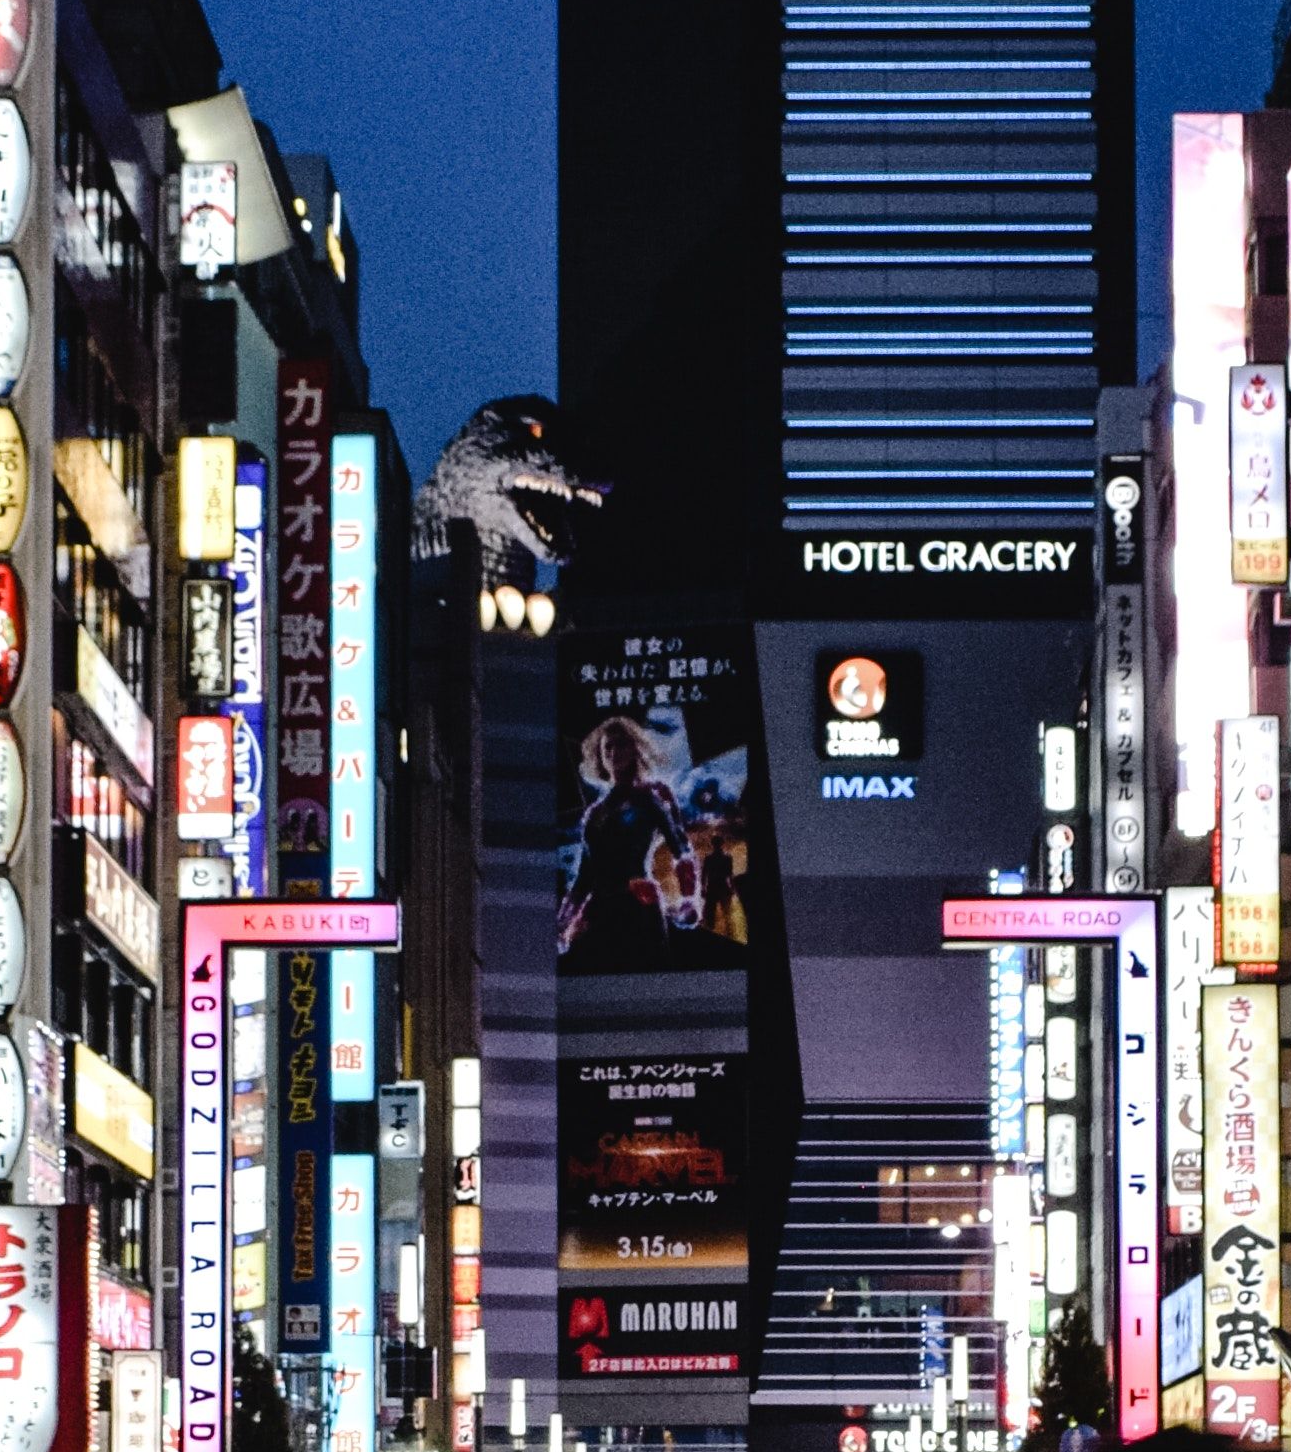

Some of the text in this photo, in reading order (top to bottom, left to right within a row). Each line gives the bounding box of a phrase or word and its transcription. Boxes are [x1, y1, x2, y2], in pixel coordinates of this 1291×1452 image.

[282, 378, 324, 776] カラオケ歌広場
[804, 540, 1077, 572] HOTEL GRACERY
[334, 467, 363, 1071] カラオケ&パーテー館
[821, 775, 916, 799] IMAX
[243, 913, 370, 936] KABUKI町
[953, 910, 1122, 926] CENTRAL ROAD
[1224, 996, 1256, 1176] きんくら酒場
[32, 1210, 54, 1304] 大衆酒場
[190, 993, 217, 1441] GODZILLA ROAD
[619, 1300, 738, 1332] MARUHAN
[1211, 1223, 1277, 1371] 金の蔵
